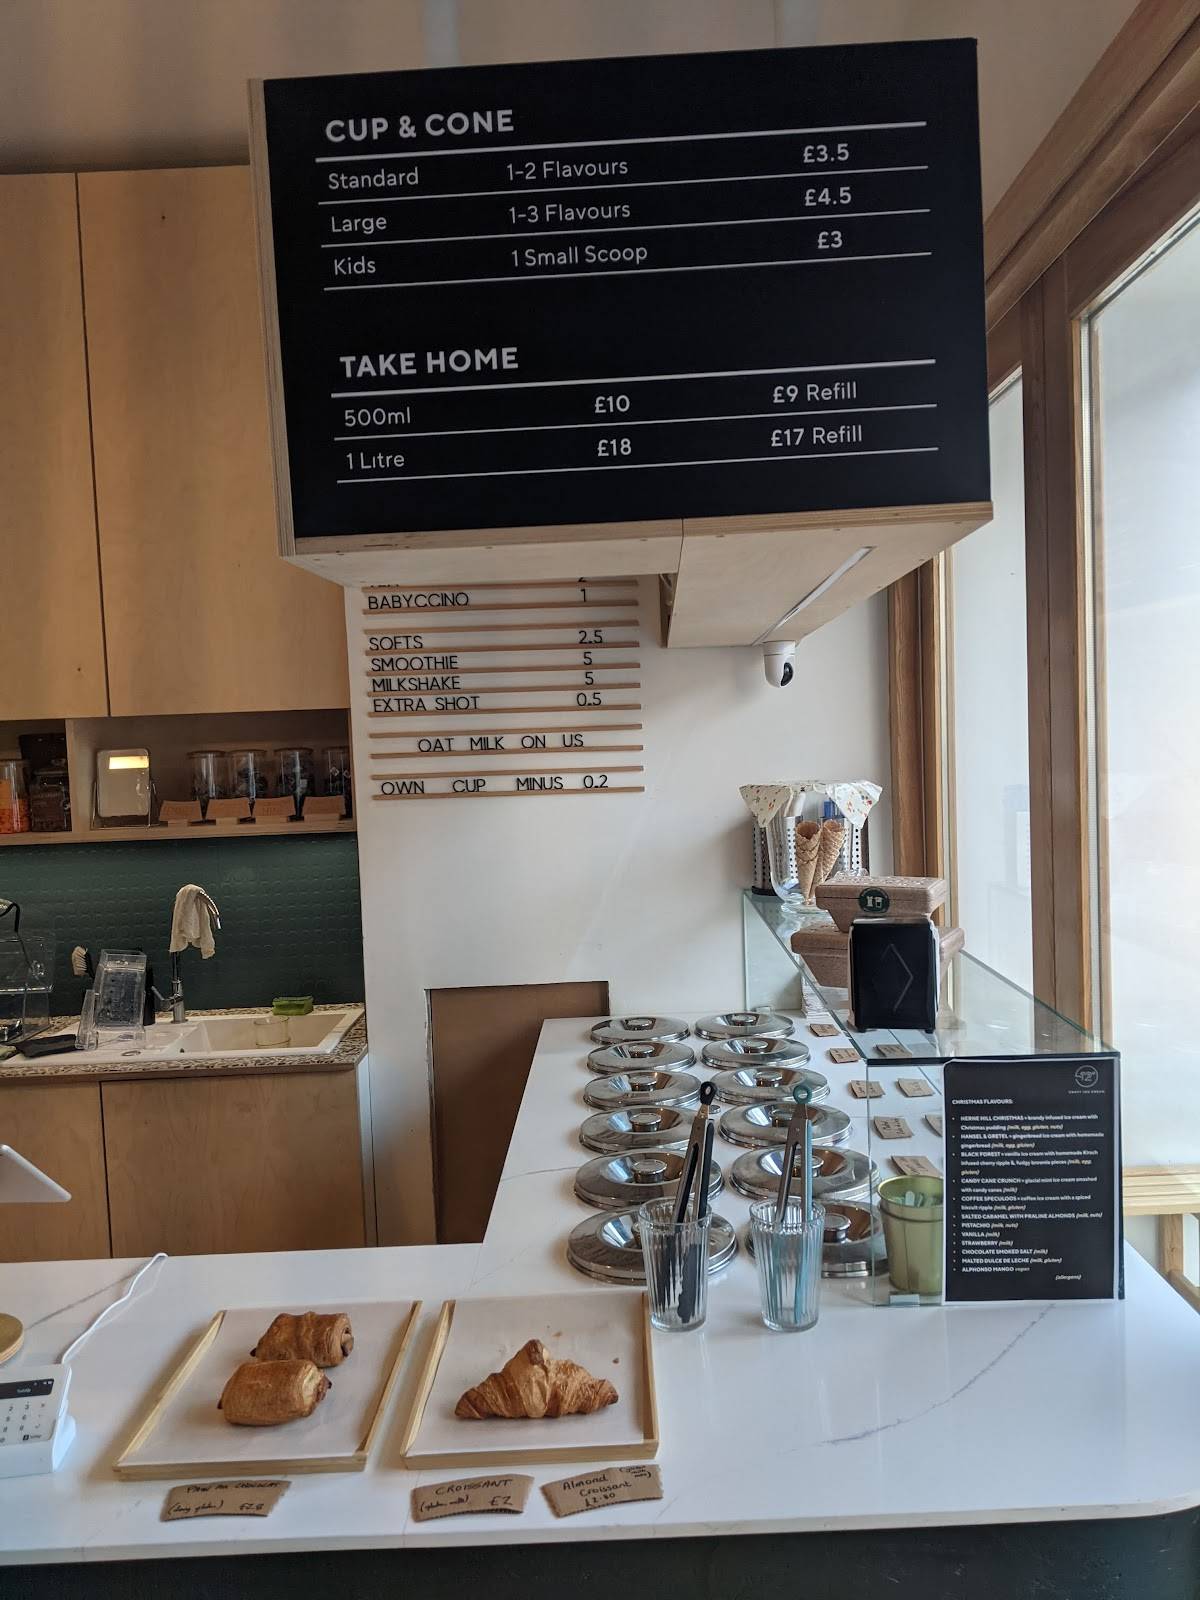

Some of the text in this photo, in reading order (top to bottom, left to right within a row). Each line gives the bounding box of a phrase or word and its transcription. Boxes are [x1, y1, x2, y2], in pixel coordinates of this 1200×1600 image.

[325, 109, 514, 142] CUP & CONE
[328, 144, 849, 189] Standard 1-2 Flavours £3.5
[331, 187, 851, 234] Large 1-3 Flavours £4.5
[334, 231, 842, 275] Kids 1 Small Scoop £3
[340, 347, 518, 378] TAKE HOME
[344, 381, 857, 427] 500ml £10 £9 Refill
[346, 425, 862, 470] 1 Litre £18 £17 Refill
[368, 589, 586, 610] BABYCCINO 1
[369, 630, 603, 650] SOFTS 2.5
[371, 652, 592, 672] SMOOTHIE 5
[372, 672, 594, 692] MILKSHAKE 5
[374, 692, 602, 712] EXTRA SHOT 0.5
[417, 734, 584, 753] OAT MILK ON US
[381, 775, 608, 796] OWN CUP MINUS 0.2
[435, 1479, 514, 1496] CROISSANT
[563, 1474, 608, 1490] Almond
[579, 1481, 632, 1497] Croissant
